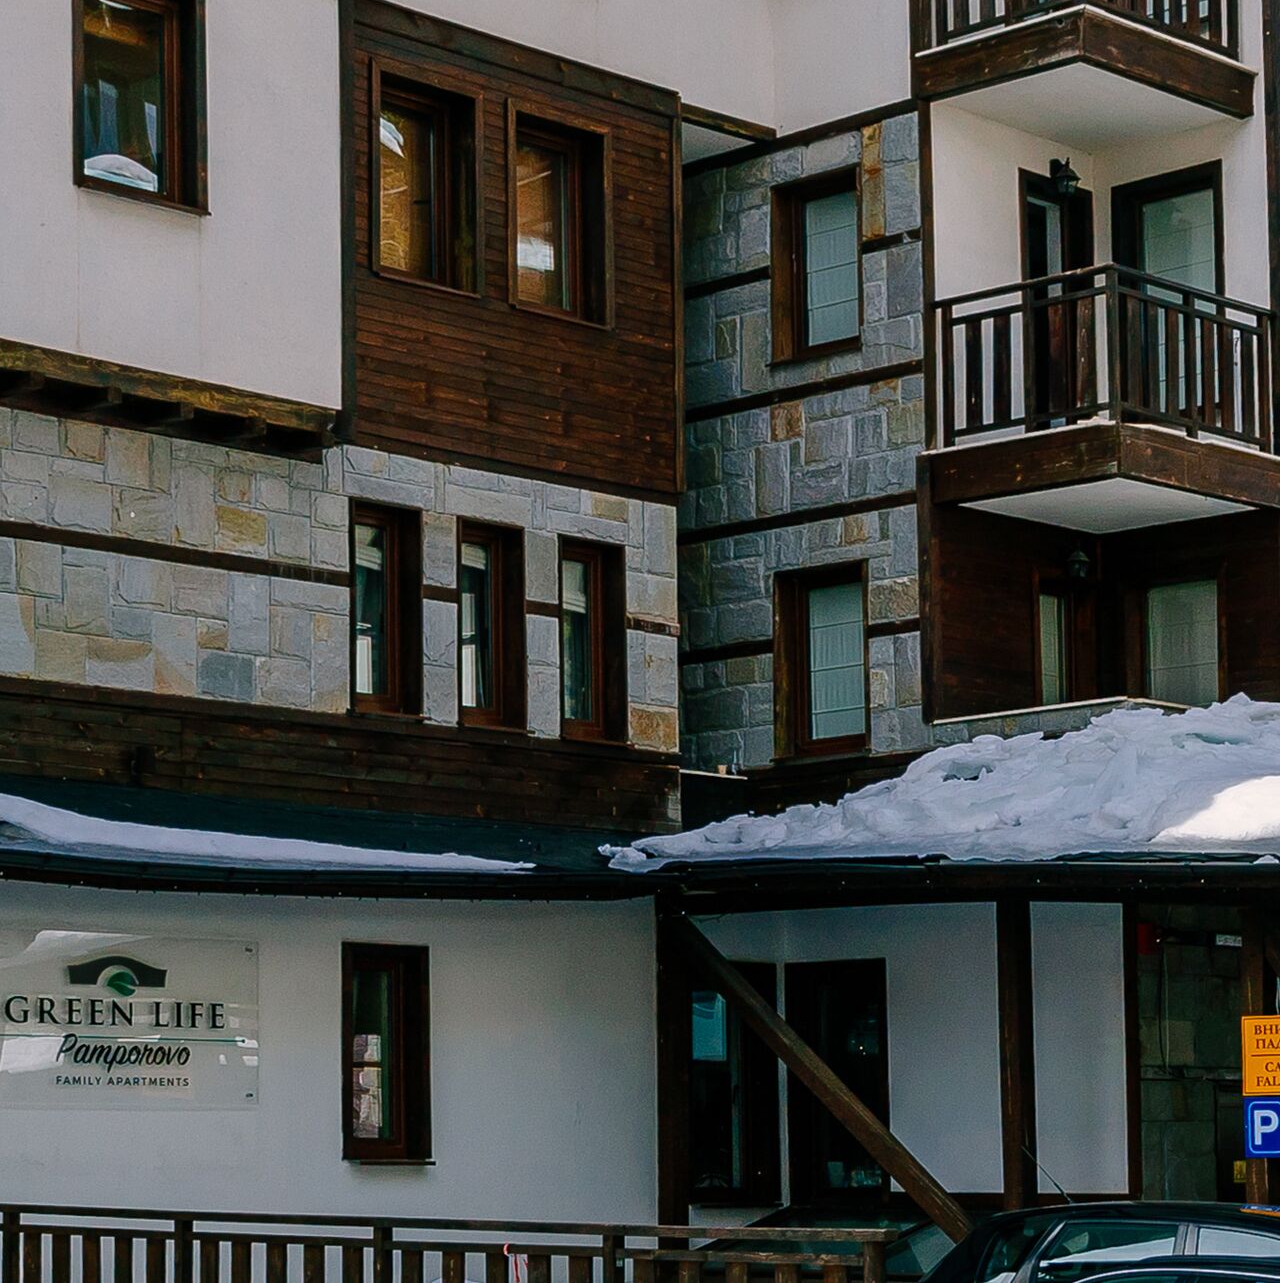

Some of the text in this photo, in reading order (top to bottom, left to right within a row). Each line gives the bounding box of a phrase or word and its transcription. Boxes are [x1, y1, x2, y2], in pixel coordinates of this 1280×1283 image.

[4, 995, 225, 1029] GREEN LIFE
[56, 1033, 191, 1073] Pamporovo
[56, 1075, 190, 1087] FAMILY APARTMENTS
[1253, 1109, 1279, 1145] P
